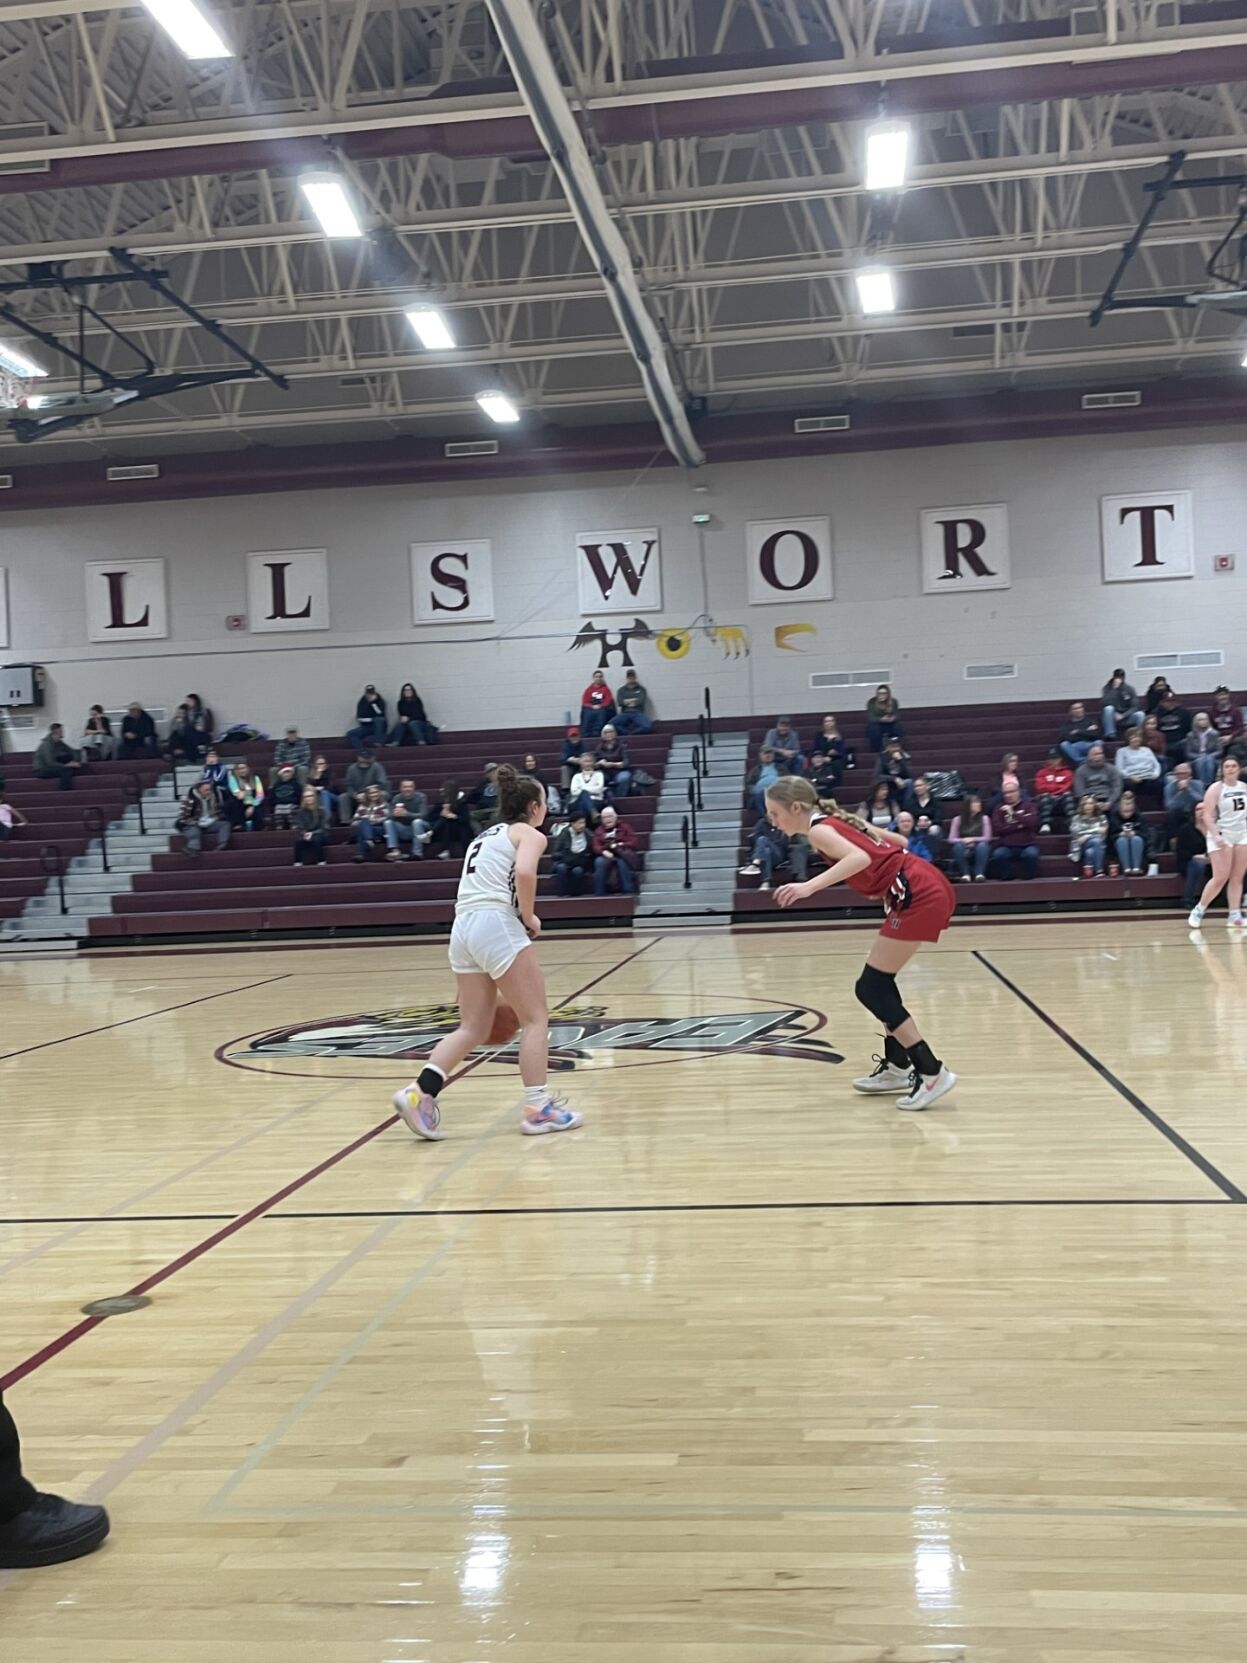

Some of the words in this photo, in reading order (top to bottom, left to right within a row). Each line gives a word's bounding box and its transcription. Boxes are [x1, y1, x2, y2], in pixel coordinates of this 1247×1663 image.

[1232, 797, 1245, 812] 15
[466, 841, 483, 875] 2
[226, 1010, 802, 1059] EAES
